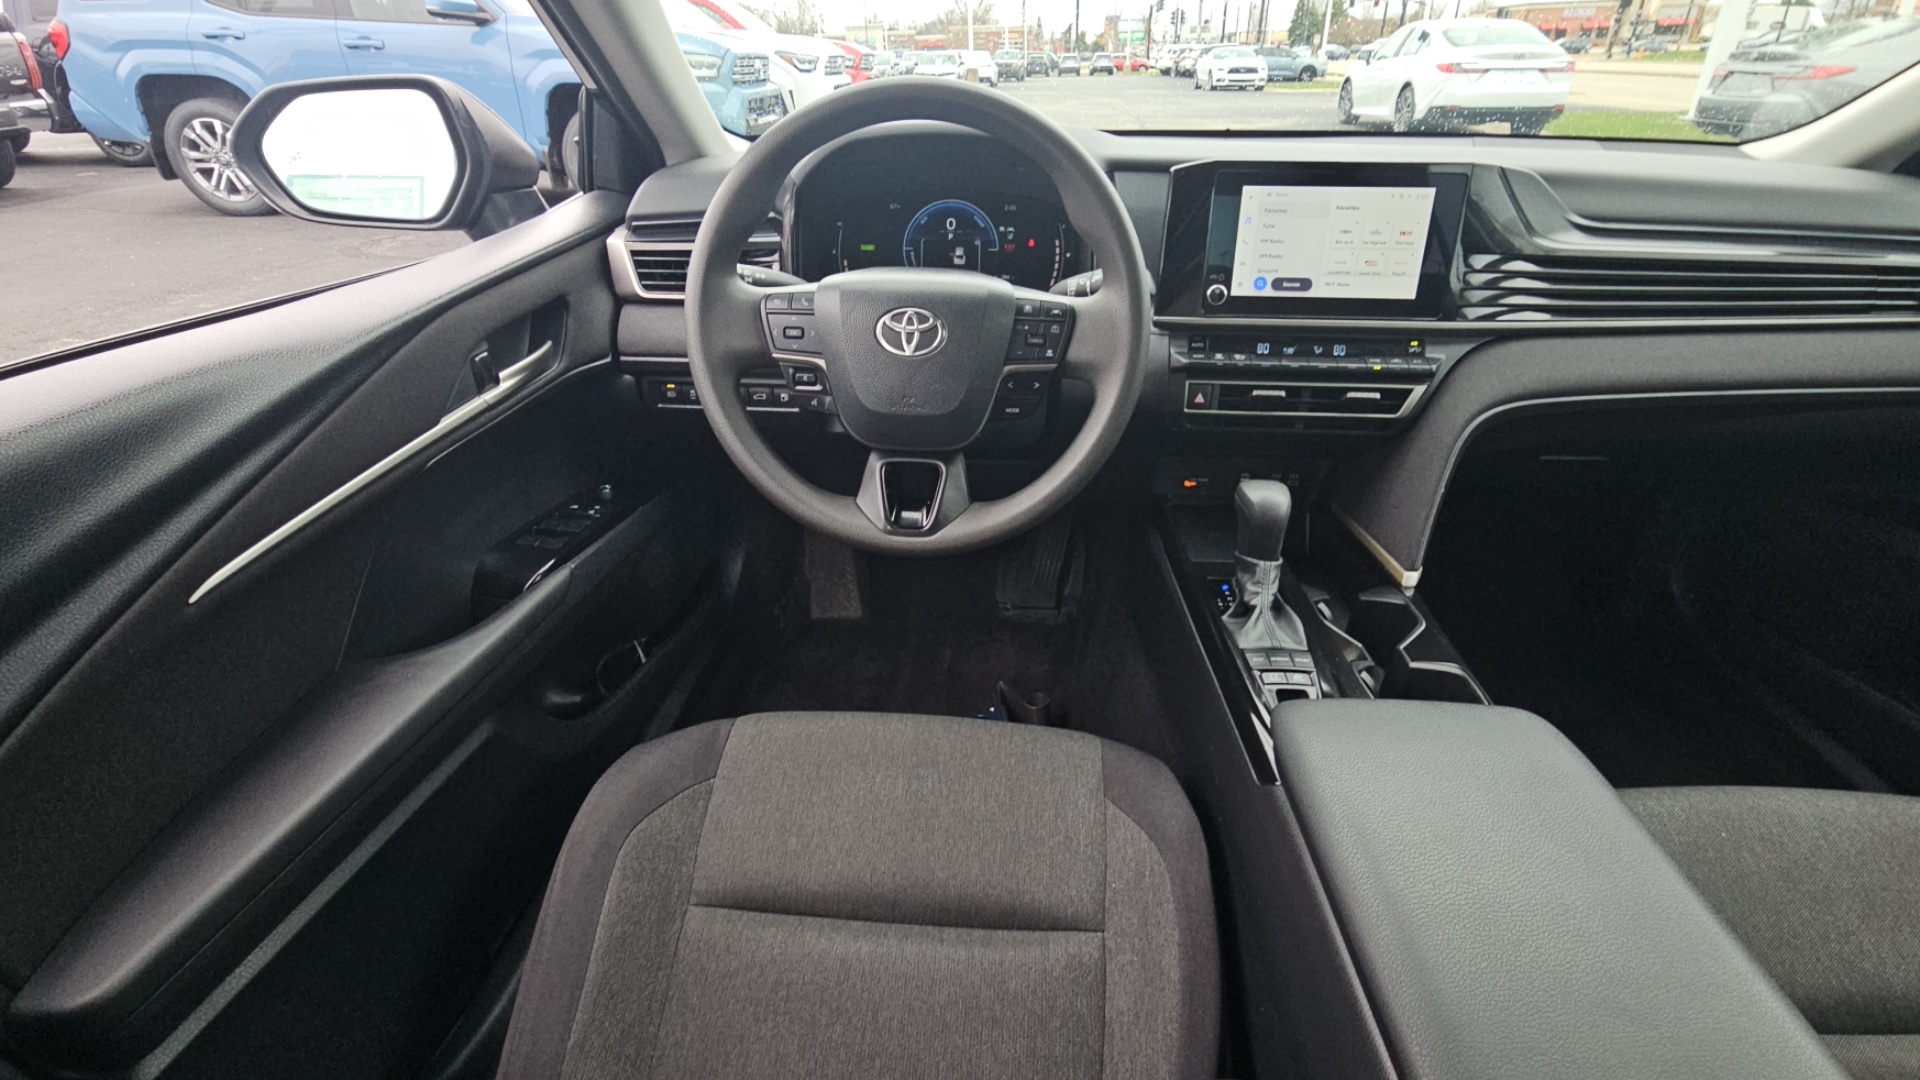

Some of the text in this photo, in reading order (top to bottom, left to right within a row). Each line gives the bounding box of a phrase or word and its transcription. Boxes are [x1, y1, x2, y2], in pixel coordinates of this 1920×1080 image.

[946, 217, 956, 231] 0
[1256, 342, 1270, 355] 80
[1333, 344, 1346, 356] 80
